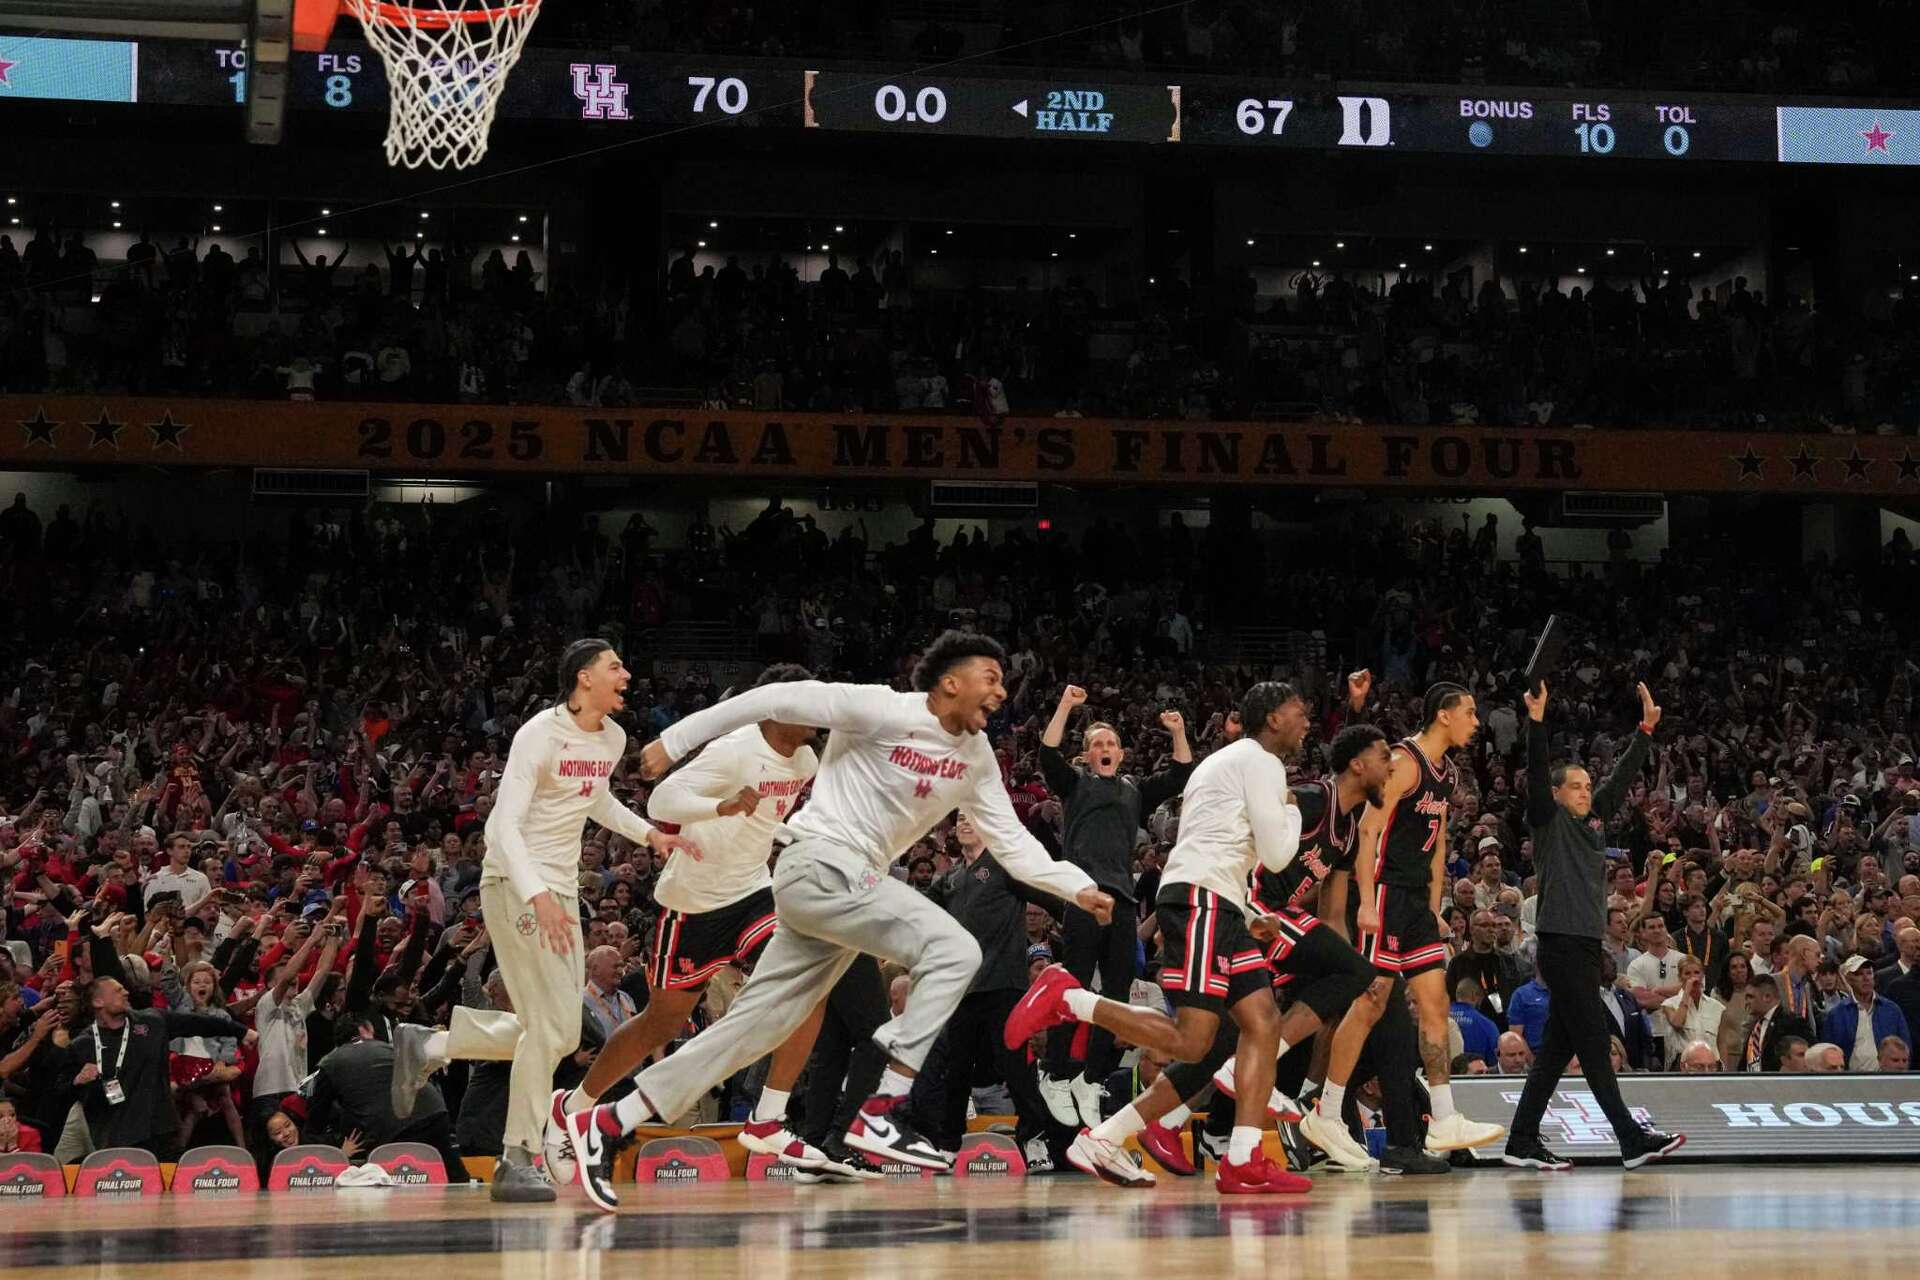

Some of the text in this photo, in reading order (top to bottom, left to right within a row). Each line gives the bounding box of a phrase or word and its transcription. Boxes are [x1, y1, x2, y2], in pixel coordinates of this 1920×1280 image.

[215, 49, 246, 69] TO
[318, 54, 362, 73] FLS
[325, 75, 352, 108] 8
[688, 76, 749, 115] 70
[1045, 89, 1106, 112] 2ND
[874, 84, 947, 123] 0.0
[1459, 99, 1535, 120] BONUS
[1572, 103, 1611, 122] FLS
[1034, 109, 1114, 133] HALF
[1236, 98, 1293, 135] 67
[1654, 105, 1697, 124] TOL
[1574, 123, 1616, 154] 10
[1663, 124, 1690, 156] 0
[358, 418, 545, 461] 2025
[583, 419, 797, 465] NCAA
[1111, 430, 1346, 475] FINAL
[1382, 436, 1583, 478] FOUR
[559, 760, 597, 777] NOTHING
[1422, 818, 1439, 852] 7
[656, 1168, 698, 1178] FINAL FOUR
[766, 1166, 798, 1176] FINAL FO
[968, 1161, 1007, 1172] FINAL FOUR
[21, 1184, 43, 1193] FOUR
[96, 1179, 141, 1191] FINAL FOUR
[194, 1177, 239, 1188] FINAL FOUR
[290, 1176, 333, 1186] FINAL FOUR
[390, 1174, 427, 1184] NAL FOUR
